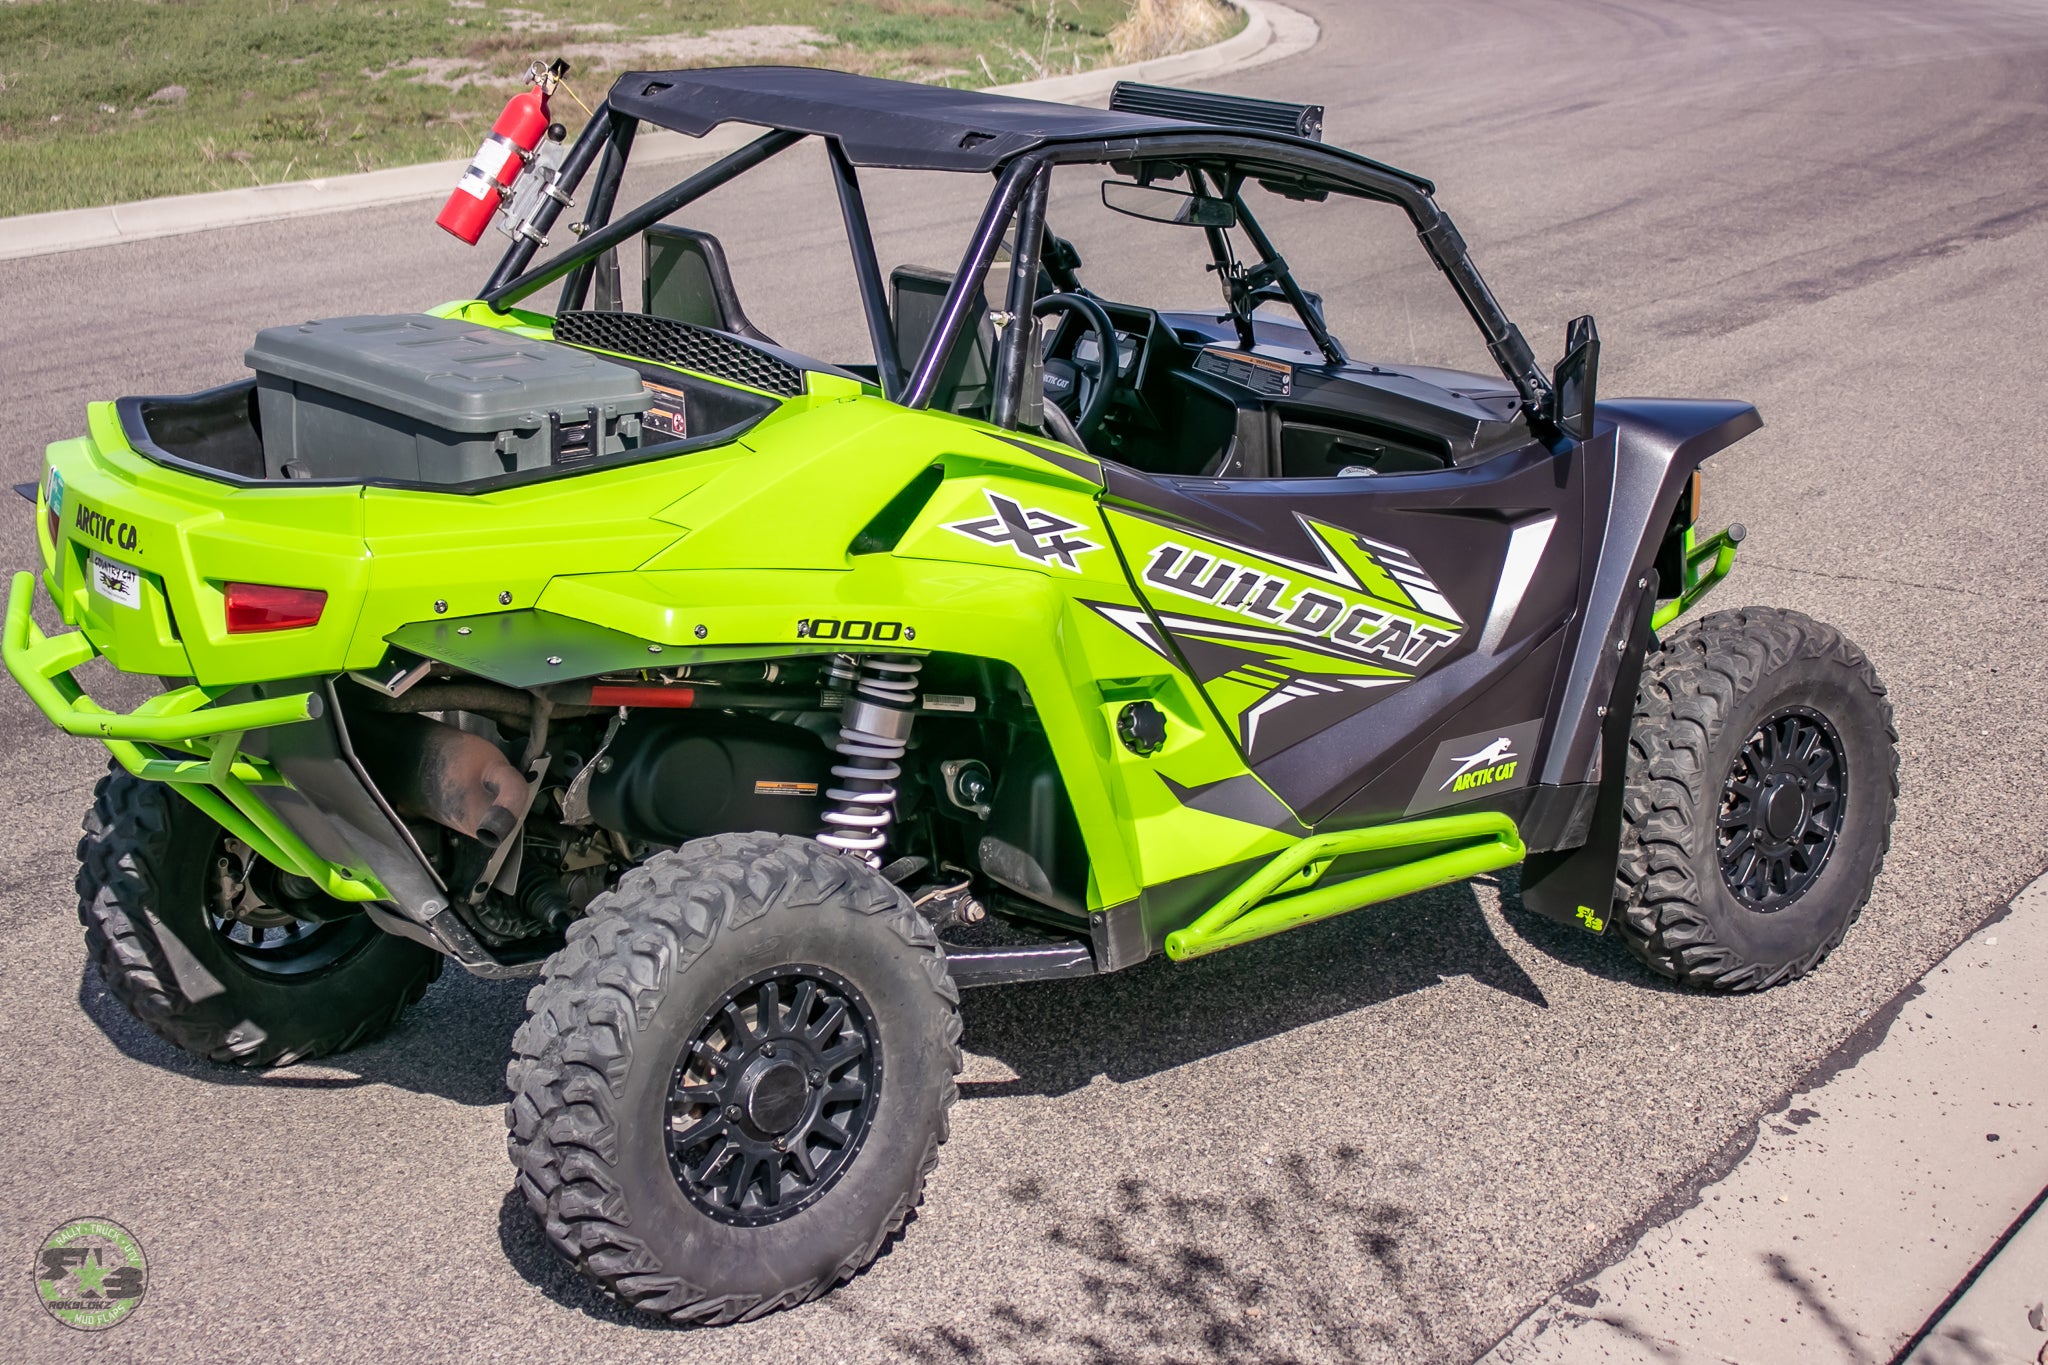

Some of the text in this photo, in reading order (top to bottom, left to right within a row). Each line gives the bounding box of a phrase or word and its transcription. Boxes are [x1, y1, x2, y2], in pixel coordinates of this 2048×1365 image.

[1042, 374, 1070, 389] RCTIC CAT
[75, 503, 144, 555] ARCTIC CA
[1143, 542, 1459, 665] WILDCAT
[1452, 761, 1518, 793] ARCTIC CAT
